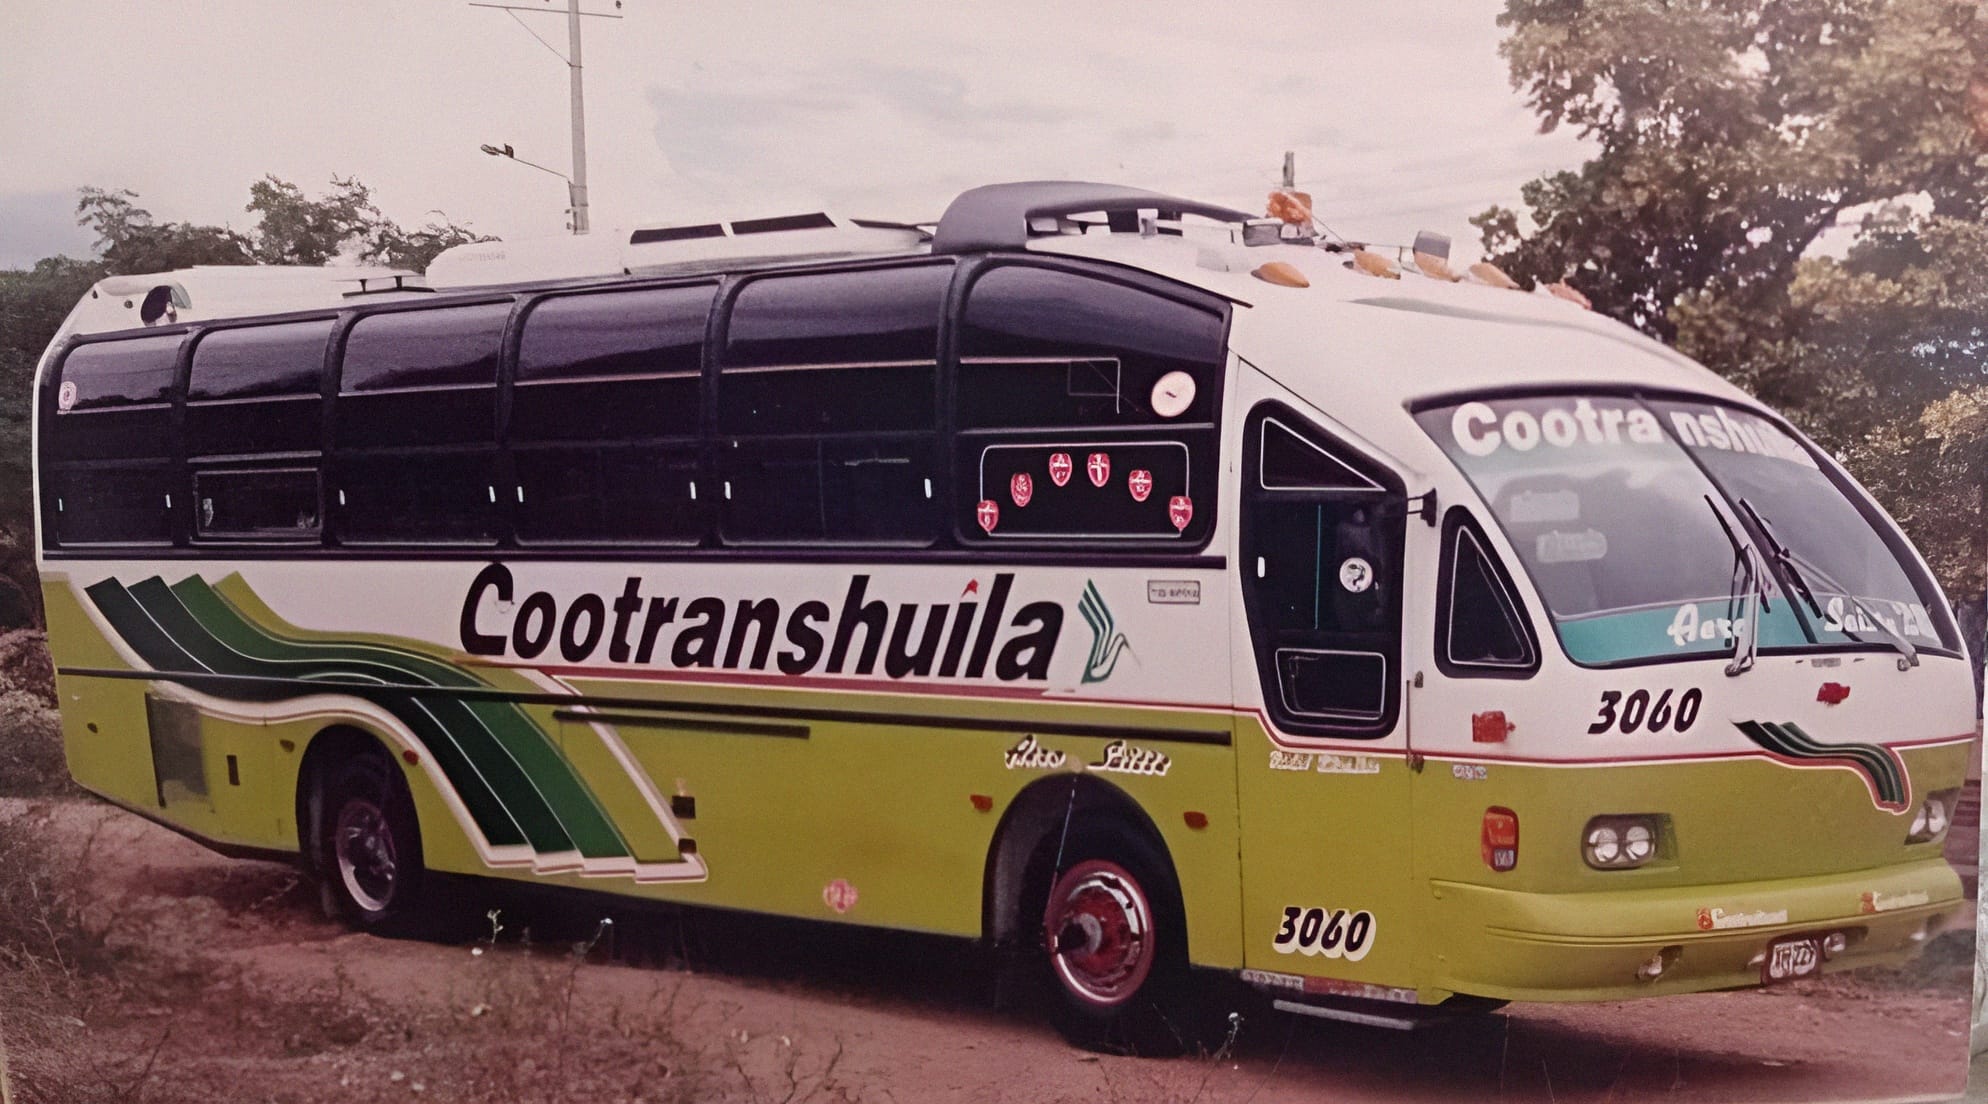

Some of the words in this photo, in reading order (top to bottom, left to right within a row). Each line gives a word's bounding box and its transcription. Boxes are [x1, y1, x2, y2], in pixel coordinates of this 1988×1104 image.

[459, 562, 1065, 681] Cootranshuila
[1587, 687, 1703, 734] 3060
[1273, 904, 1374, 957] 3060
